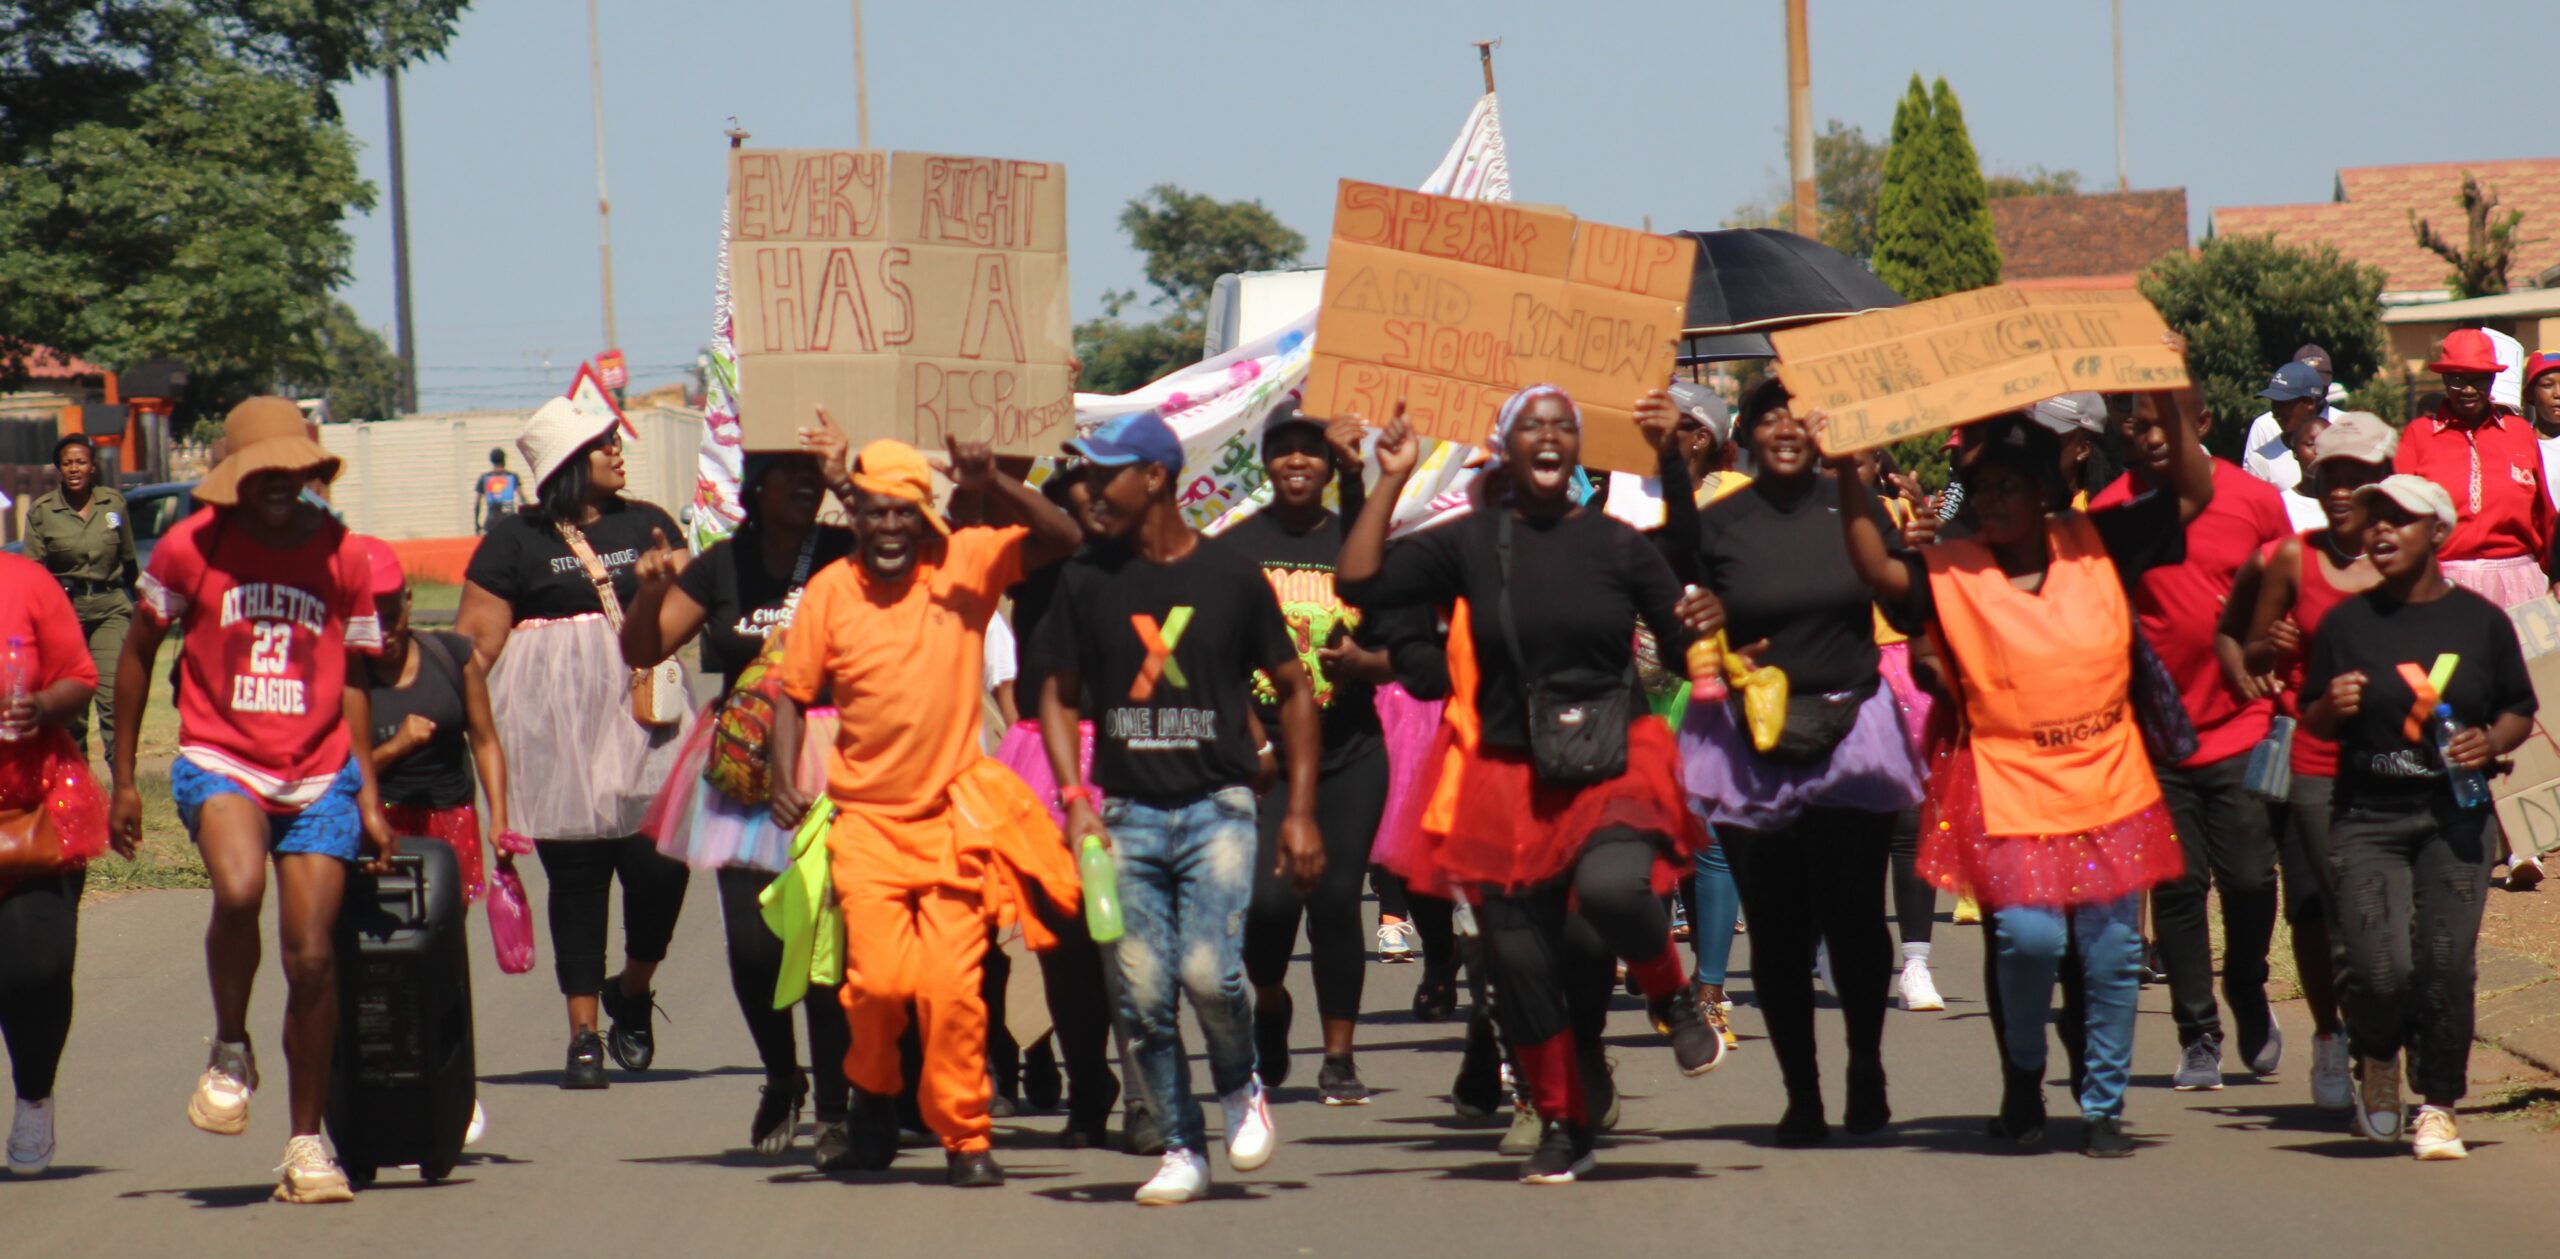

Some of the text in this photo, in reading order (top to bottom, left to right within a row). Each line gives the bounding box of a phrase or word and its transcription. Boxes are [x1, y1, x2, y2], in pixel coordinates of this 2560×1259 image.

[738, 152, 1048, 247] EVERY RIGHT
[1340, 181, 1678, 294] SPEAK UP
[756, 247, 1027, 364] HAS A
[1331, 266, 1656, 383] AND KNOW
[1381, 319, 1520, 387] YOUR
[1795, 341, 1912, 387] THE
[1927, 310, 2122, 377] RIGHT
[550, 556, 584, 573] STEV
[220, 582, 326, 635] ATHLETICS
[251, 620, 293, 674] 23
[231, 674, 306, 715] LEAGUE
[1106, 707, 1217, 740] ONE MARK
[2033, 702, 2123, 748] BRIGADE
